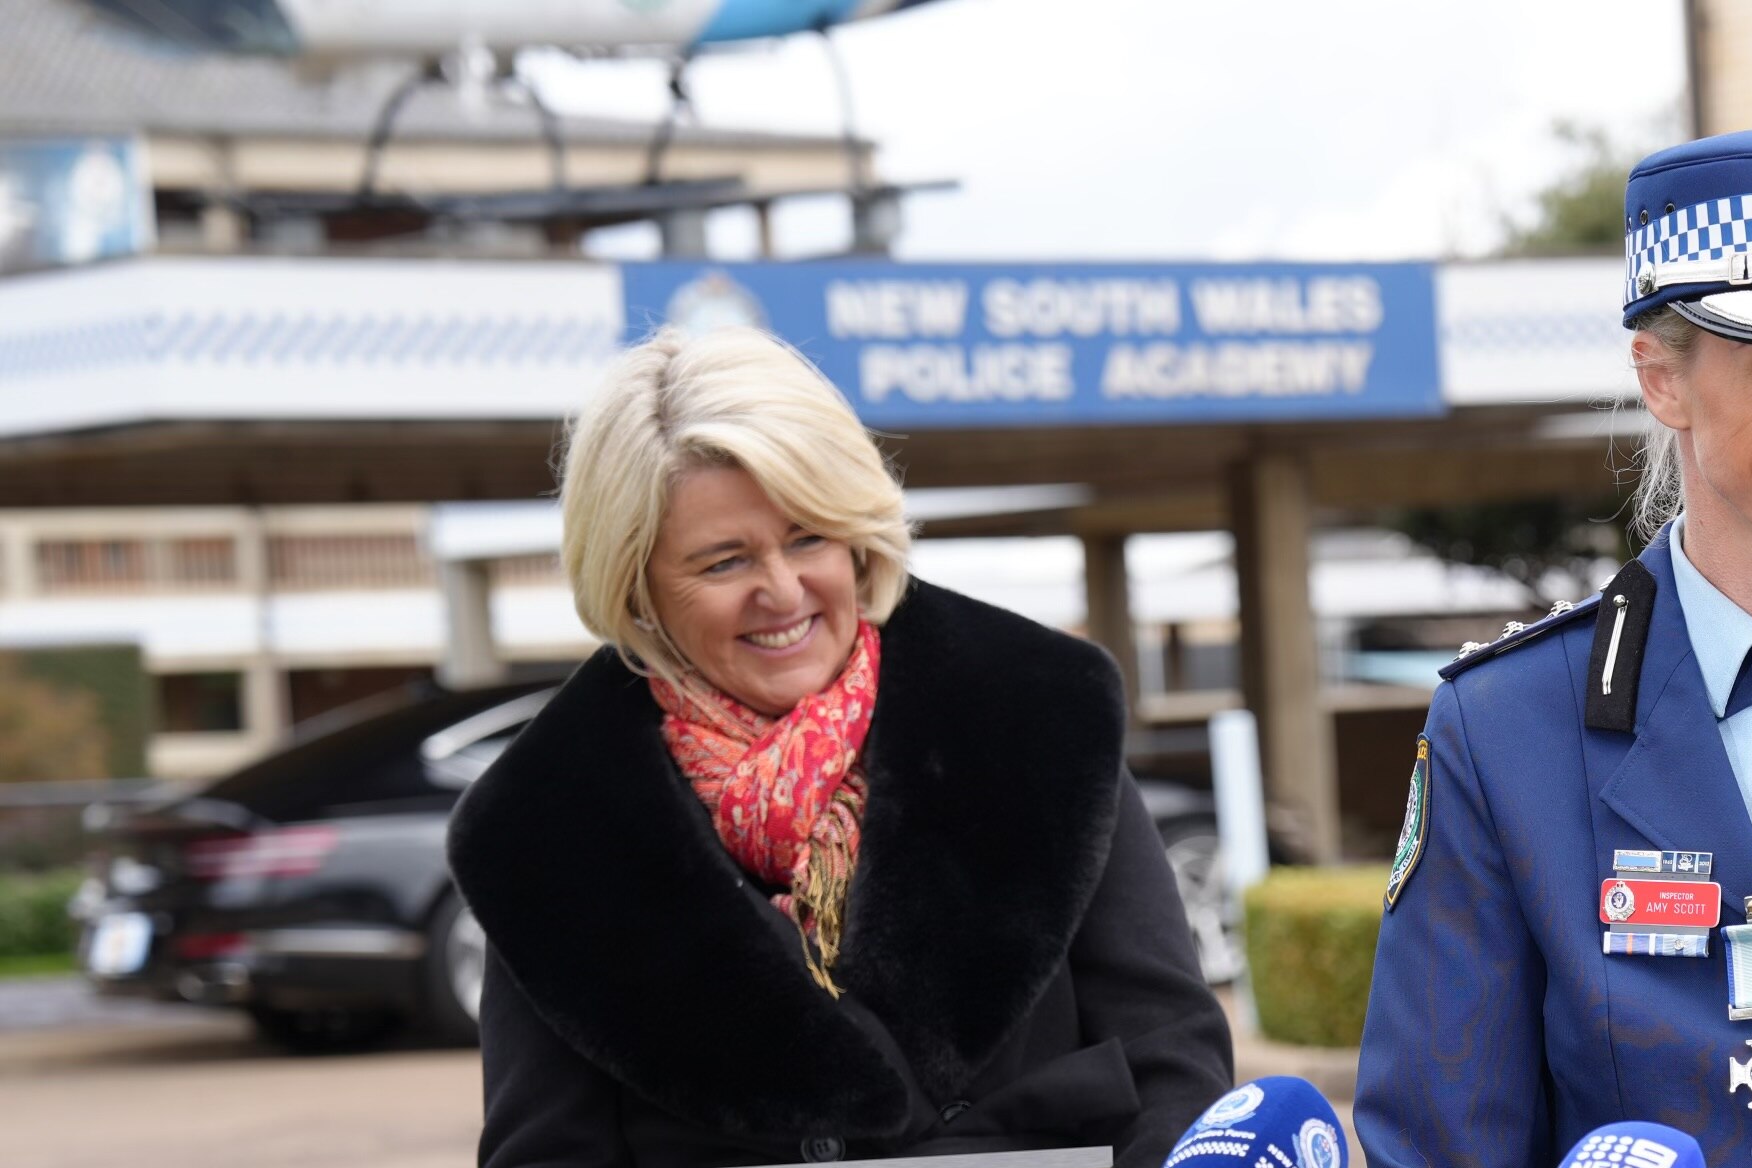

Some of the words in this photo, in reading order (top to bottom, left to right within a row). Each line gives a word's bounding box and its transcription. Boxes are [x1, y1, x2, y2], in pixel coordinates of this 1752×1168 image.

[826, 280, 966, 338] NEW
[983, 278, 1181, 337] SOUTH
[1190, 276, 1383, 335] WALES
[860, 343, 1074, 402] POLICE
[1102, 341, 1373, 399] ACADEMY
[1646, 902, 1668, 914] AMY
[1673, 903, 1706, 915] SCOTT
[1659, 892, 1694, 900] INSPECTOR
[1267, 1143, 1293, 1168] NSW
